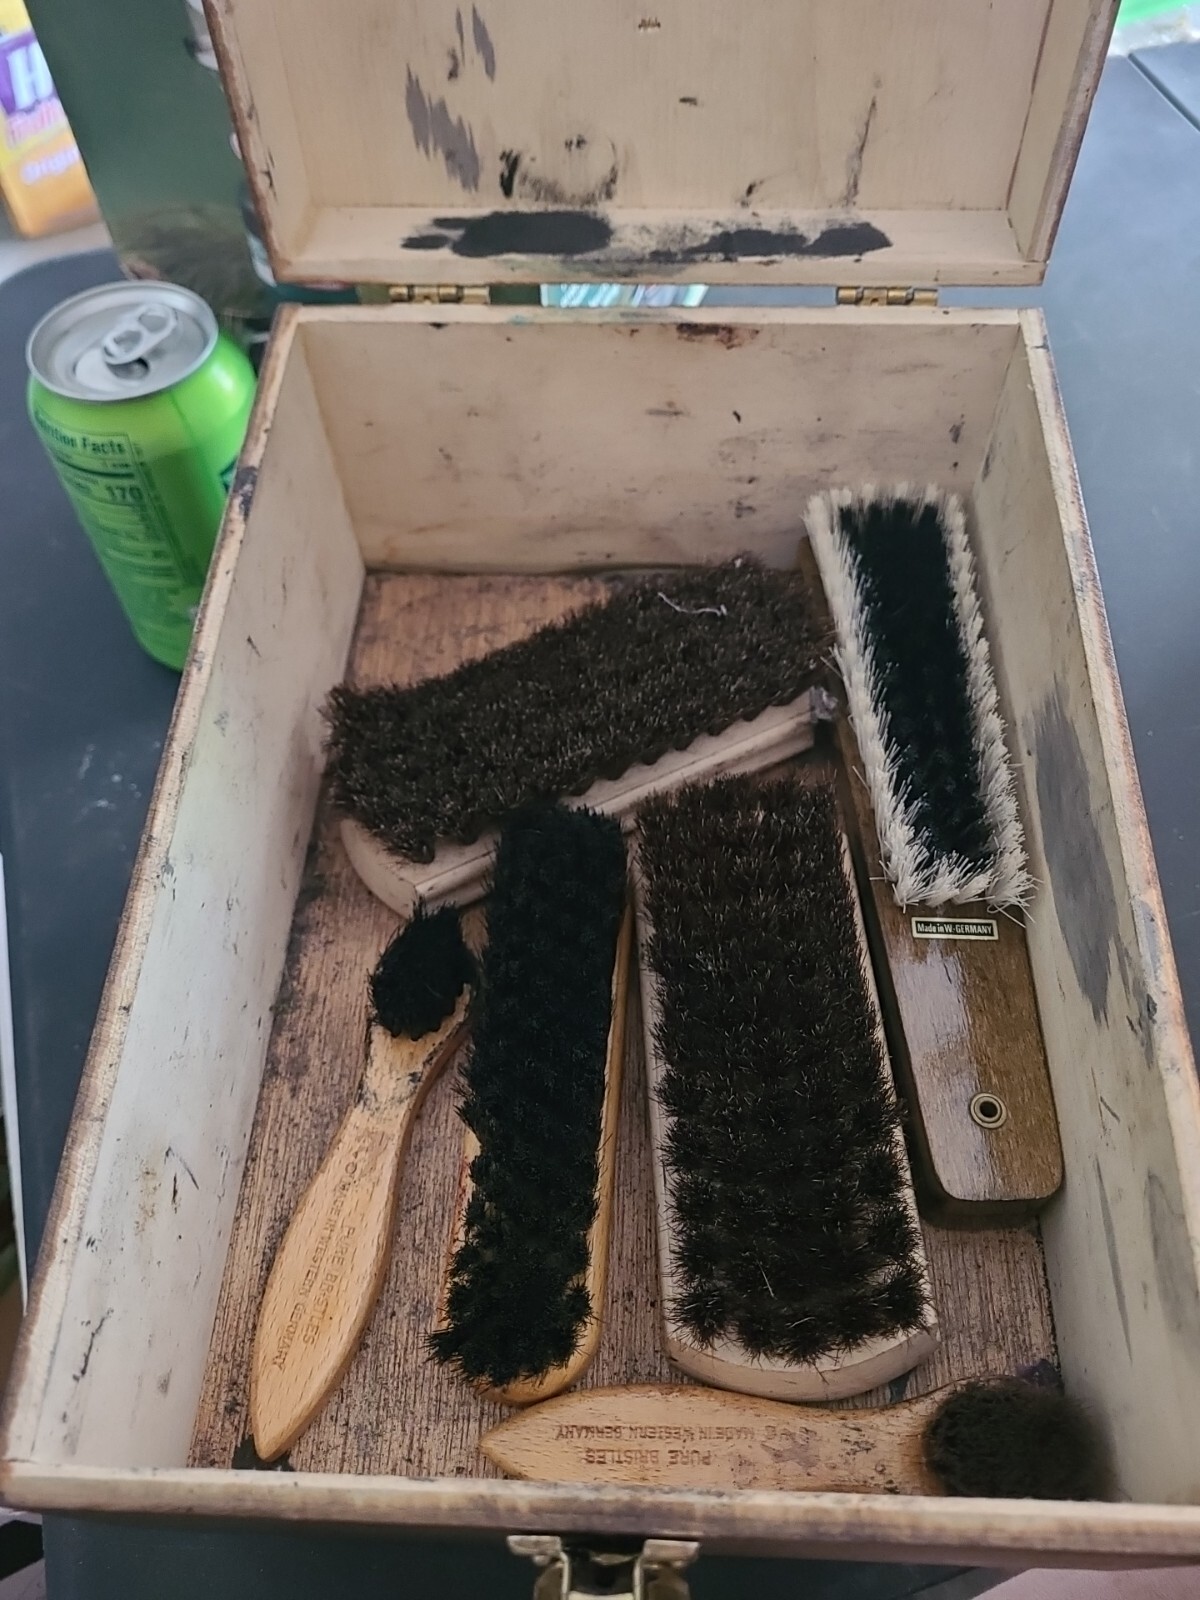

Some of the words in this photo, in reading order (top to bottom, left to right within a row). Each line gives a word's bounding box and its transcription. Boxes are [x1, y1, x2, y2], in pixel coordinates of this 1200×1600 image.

[82, 437, 124, 454] Facts
[105, 485, 143, 501] 170
[917, 923, 936, 932] Made
[937, 923, 944, 933] in
[331, 1226, 355, 1265] PURE
[299, 1233, 329, 1297] WESTERN
[271, 1302, 308, 1370] GERMANY
[555, 1425, 623, 1441] GERMANY
[584, 1449, 660, 1465] BRISTLES
[667, 1449, 712, 1466] PURE
